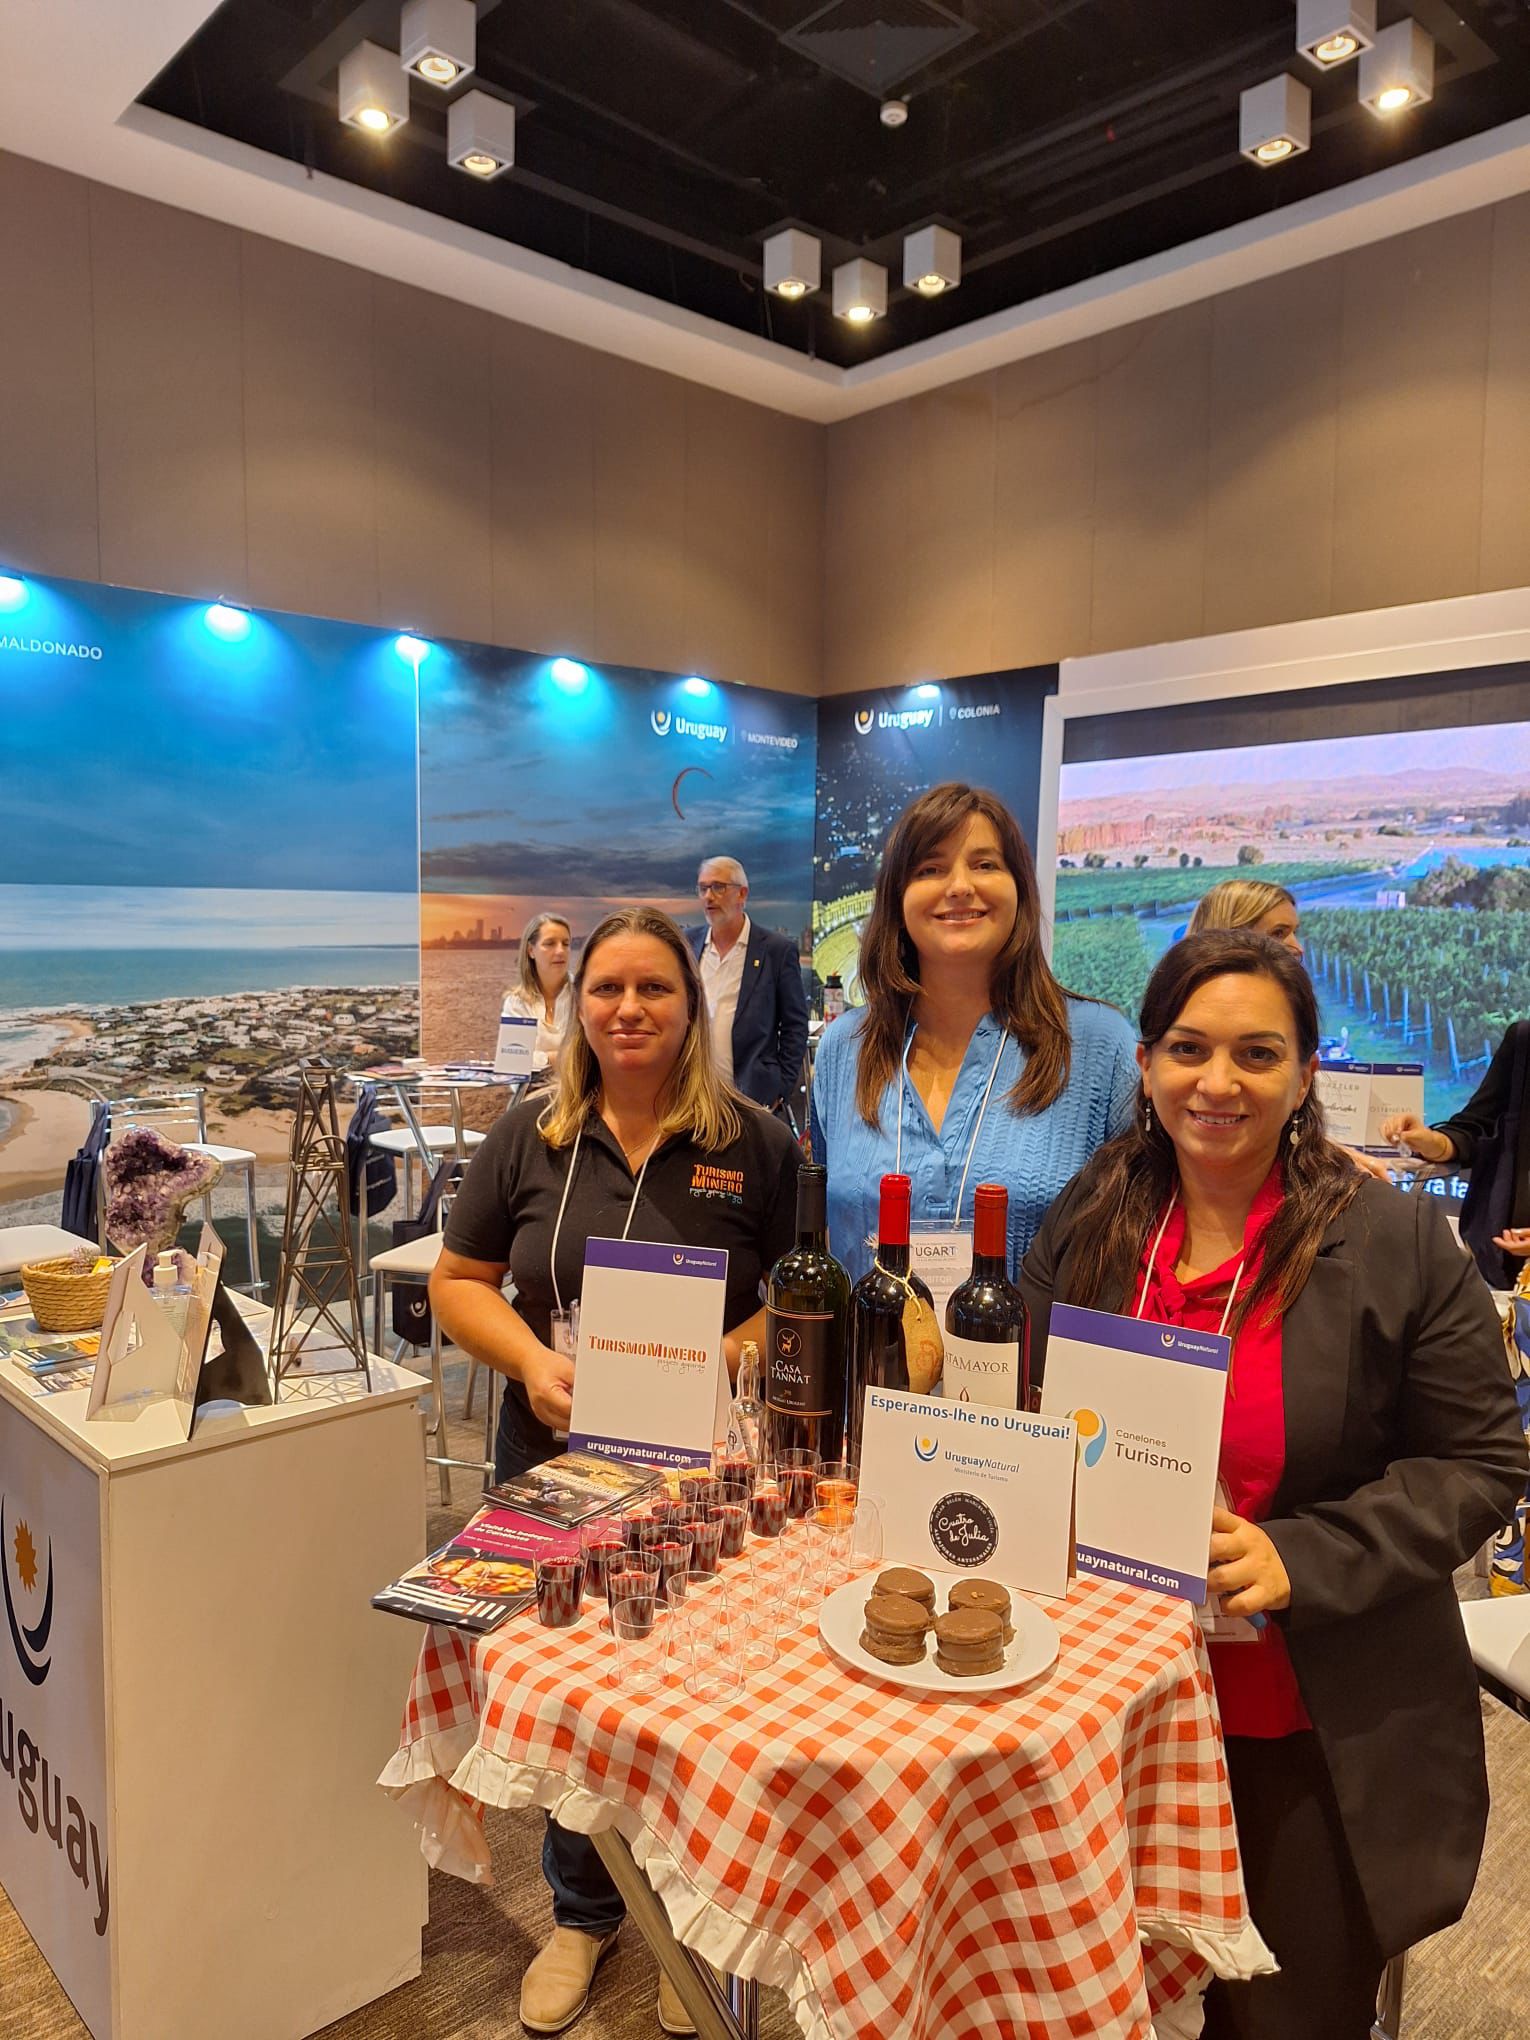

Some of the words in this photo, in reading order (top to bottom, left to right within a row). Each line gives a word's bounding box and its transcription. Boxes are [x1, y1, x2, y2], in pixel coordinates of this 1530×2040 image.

[0, 635, 103, 660] MALDONADO
[879, 708, 934, 729] Uruguay
[957, 704, 1000, 719] COLONIA
[675, 716, 727, 742] Uruguay
[747, 733, 798, 749] MONTEVIDEO
[693, 1163, 744, 1182] TURISMO
[691, 1175, 743, 1194] MINERO
[915, 1246, 956, 1257] UGART
[770, 1366, 811, 1385] TANNAT
[775, 1360, 801, 1374] CASA
[871, 1394, 977, 1424] Esperamos-lhe
[980, 1413, 1000, 1427] no
[1004, 1416, 1070, 1440] Uruguai!
[1115, 1429, 1167, 1448] Canelones
[587, 1441, 692, 1464] uruguaynatural.com
[944, 1451, 1020, 1473] UruguayNatural
[1114, 1442, 1193, 1474] Turismo
[938, 1513, 974, 1531] Cuatro
[934, 1528, 956, 1559] ALFAJORES
[957, 1542, 993, 1563] ARTESANALES
[949, 1529, 960, 1542] de
[959, 1524, 989, 1547] Julia
[1075, 1551, 1180, 1590] uaynatural.com
